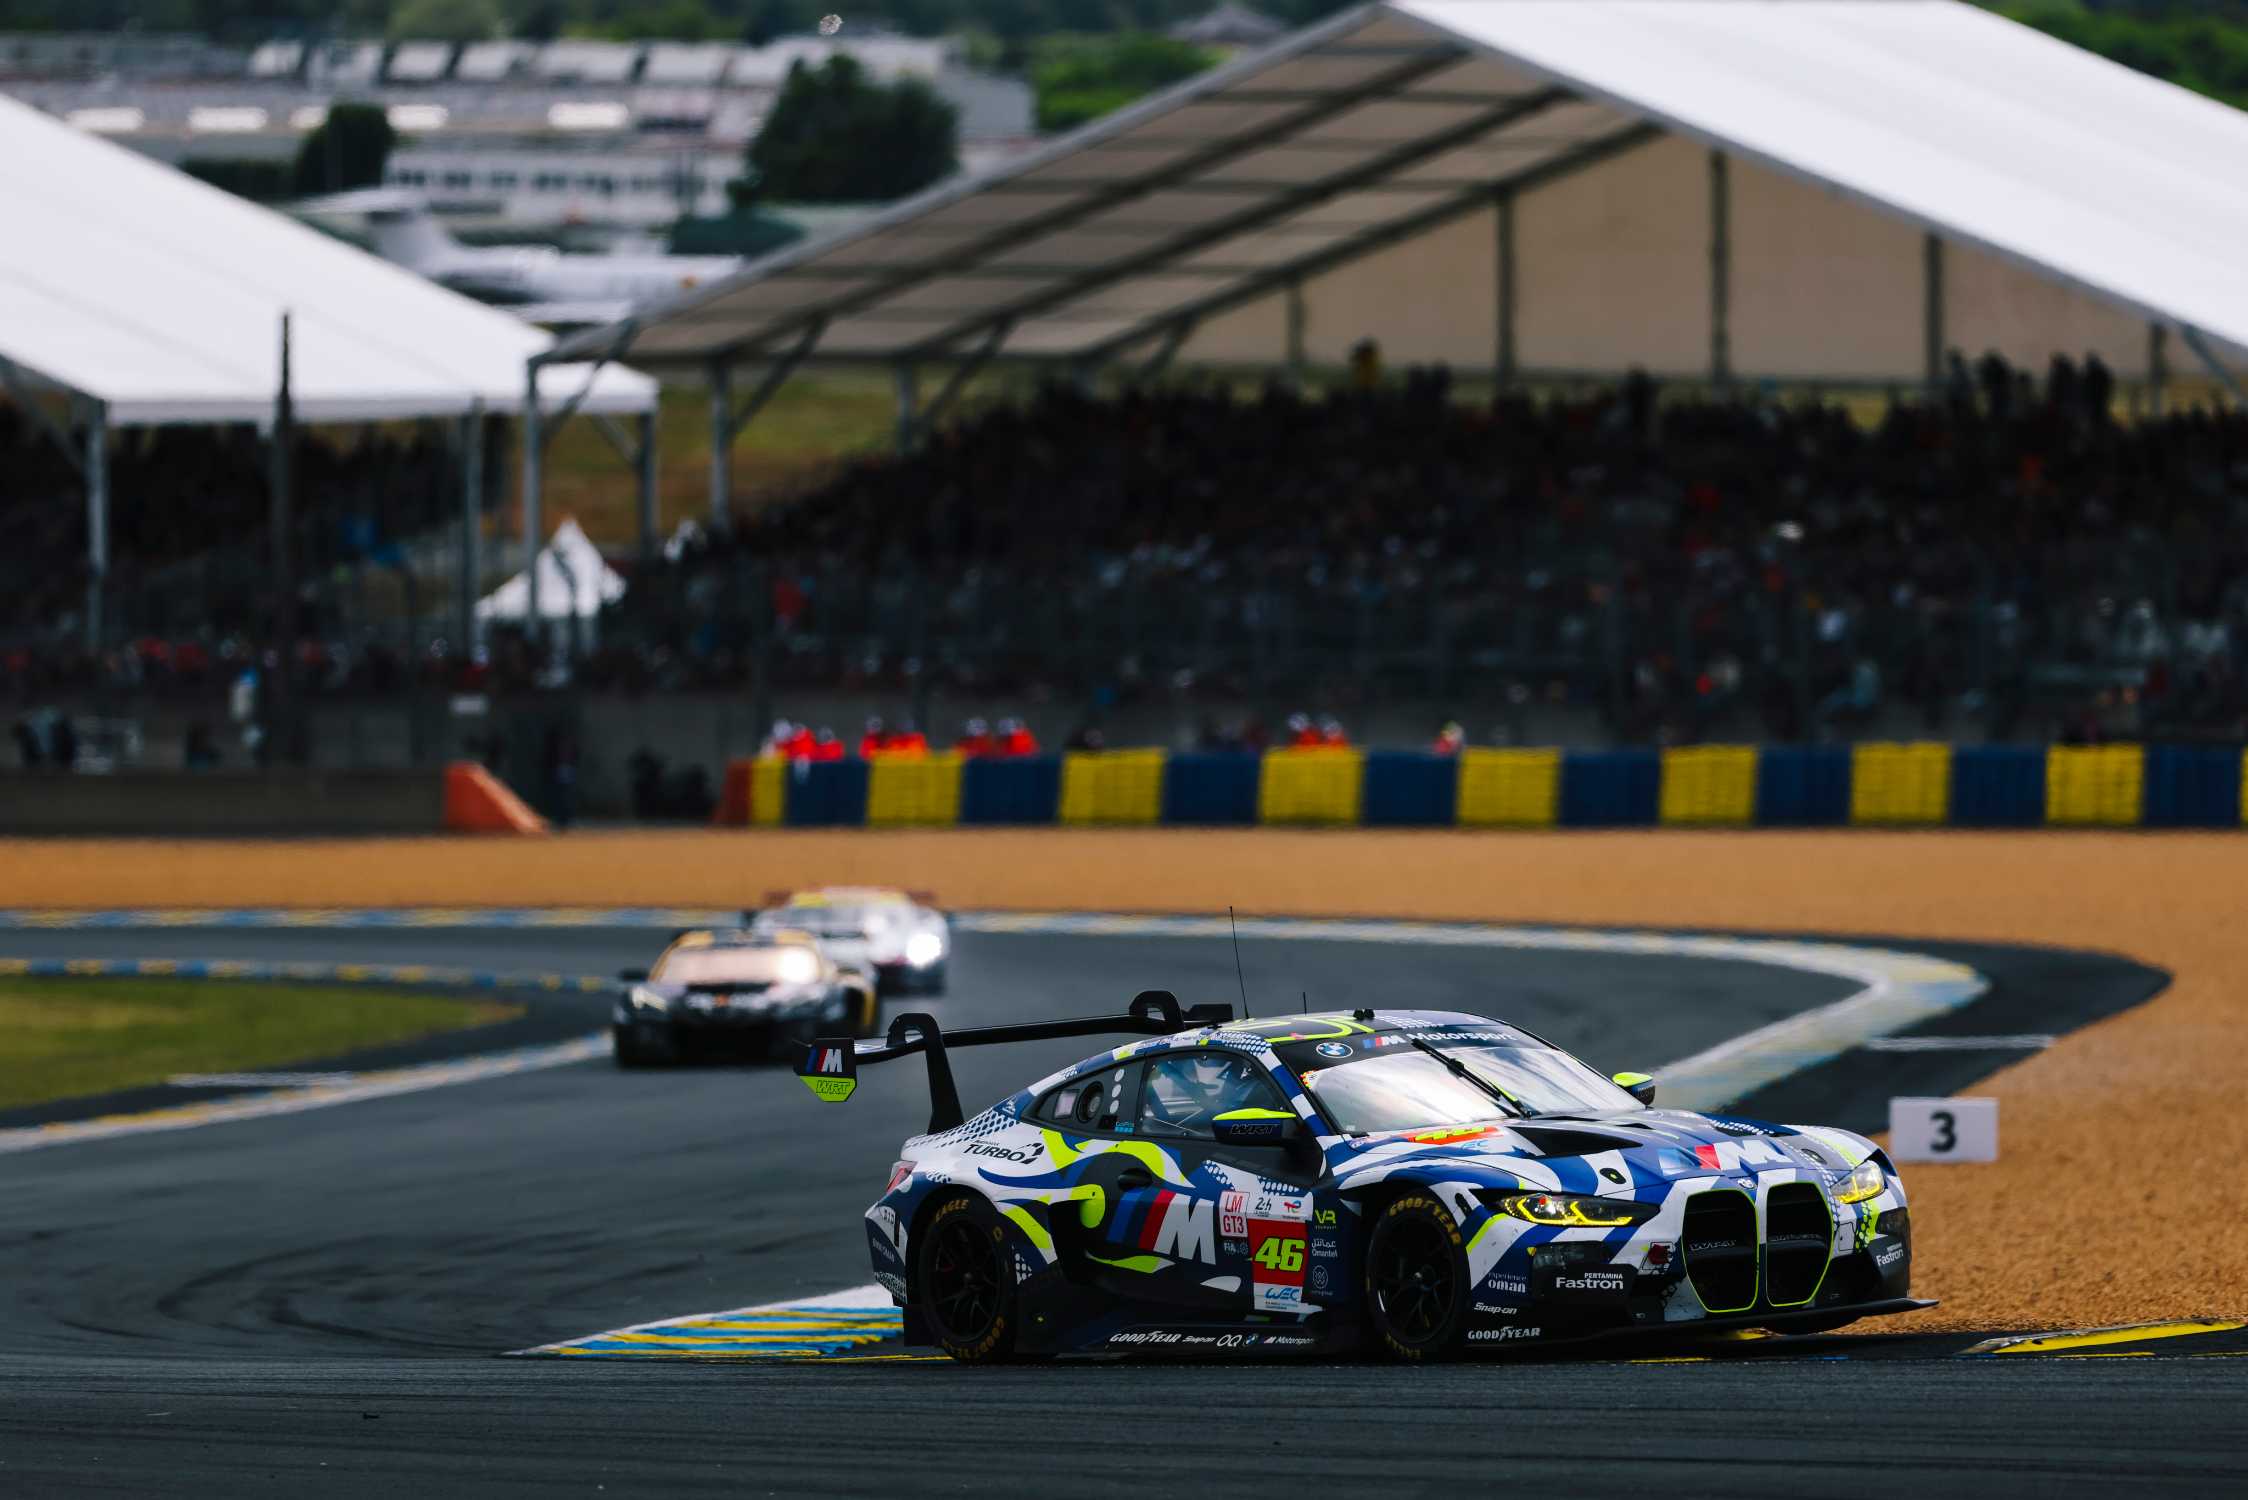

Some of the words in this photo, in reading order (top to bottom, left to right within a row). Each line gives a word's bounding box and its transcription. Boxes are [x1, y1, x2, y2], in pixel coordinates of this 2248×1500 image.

[1406, 1032, 1517, 1042] Motorsport
[821, 1048, 843, 1073] M
[815, 1080, 851, 1094] WRT
[1929, 1111, 1957, 1153] 3
[963, 1143, 1026, 1162] TURBO
[1713, 1141, 1794, 1170] M
[1224, 1192, 1243, 1213] LM
[1223, 1215, 1244, 1234] GT3
[1315, 1209, 1337, 1224] VR
[1153, 1193, 1216, 1265] M
[1254, 1237, 1306, 1272] 46
[1556, 1276, 1624, 1290] Fastron
[1584, 1272, 1623, 1280] PERTAMINA
[1488, 1279, 1526, 1294] oman
[1474, 1302, 1517, 1315] Snap-on
